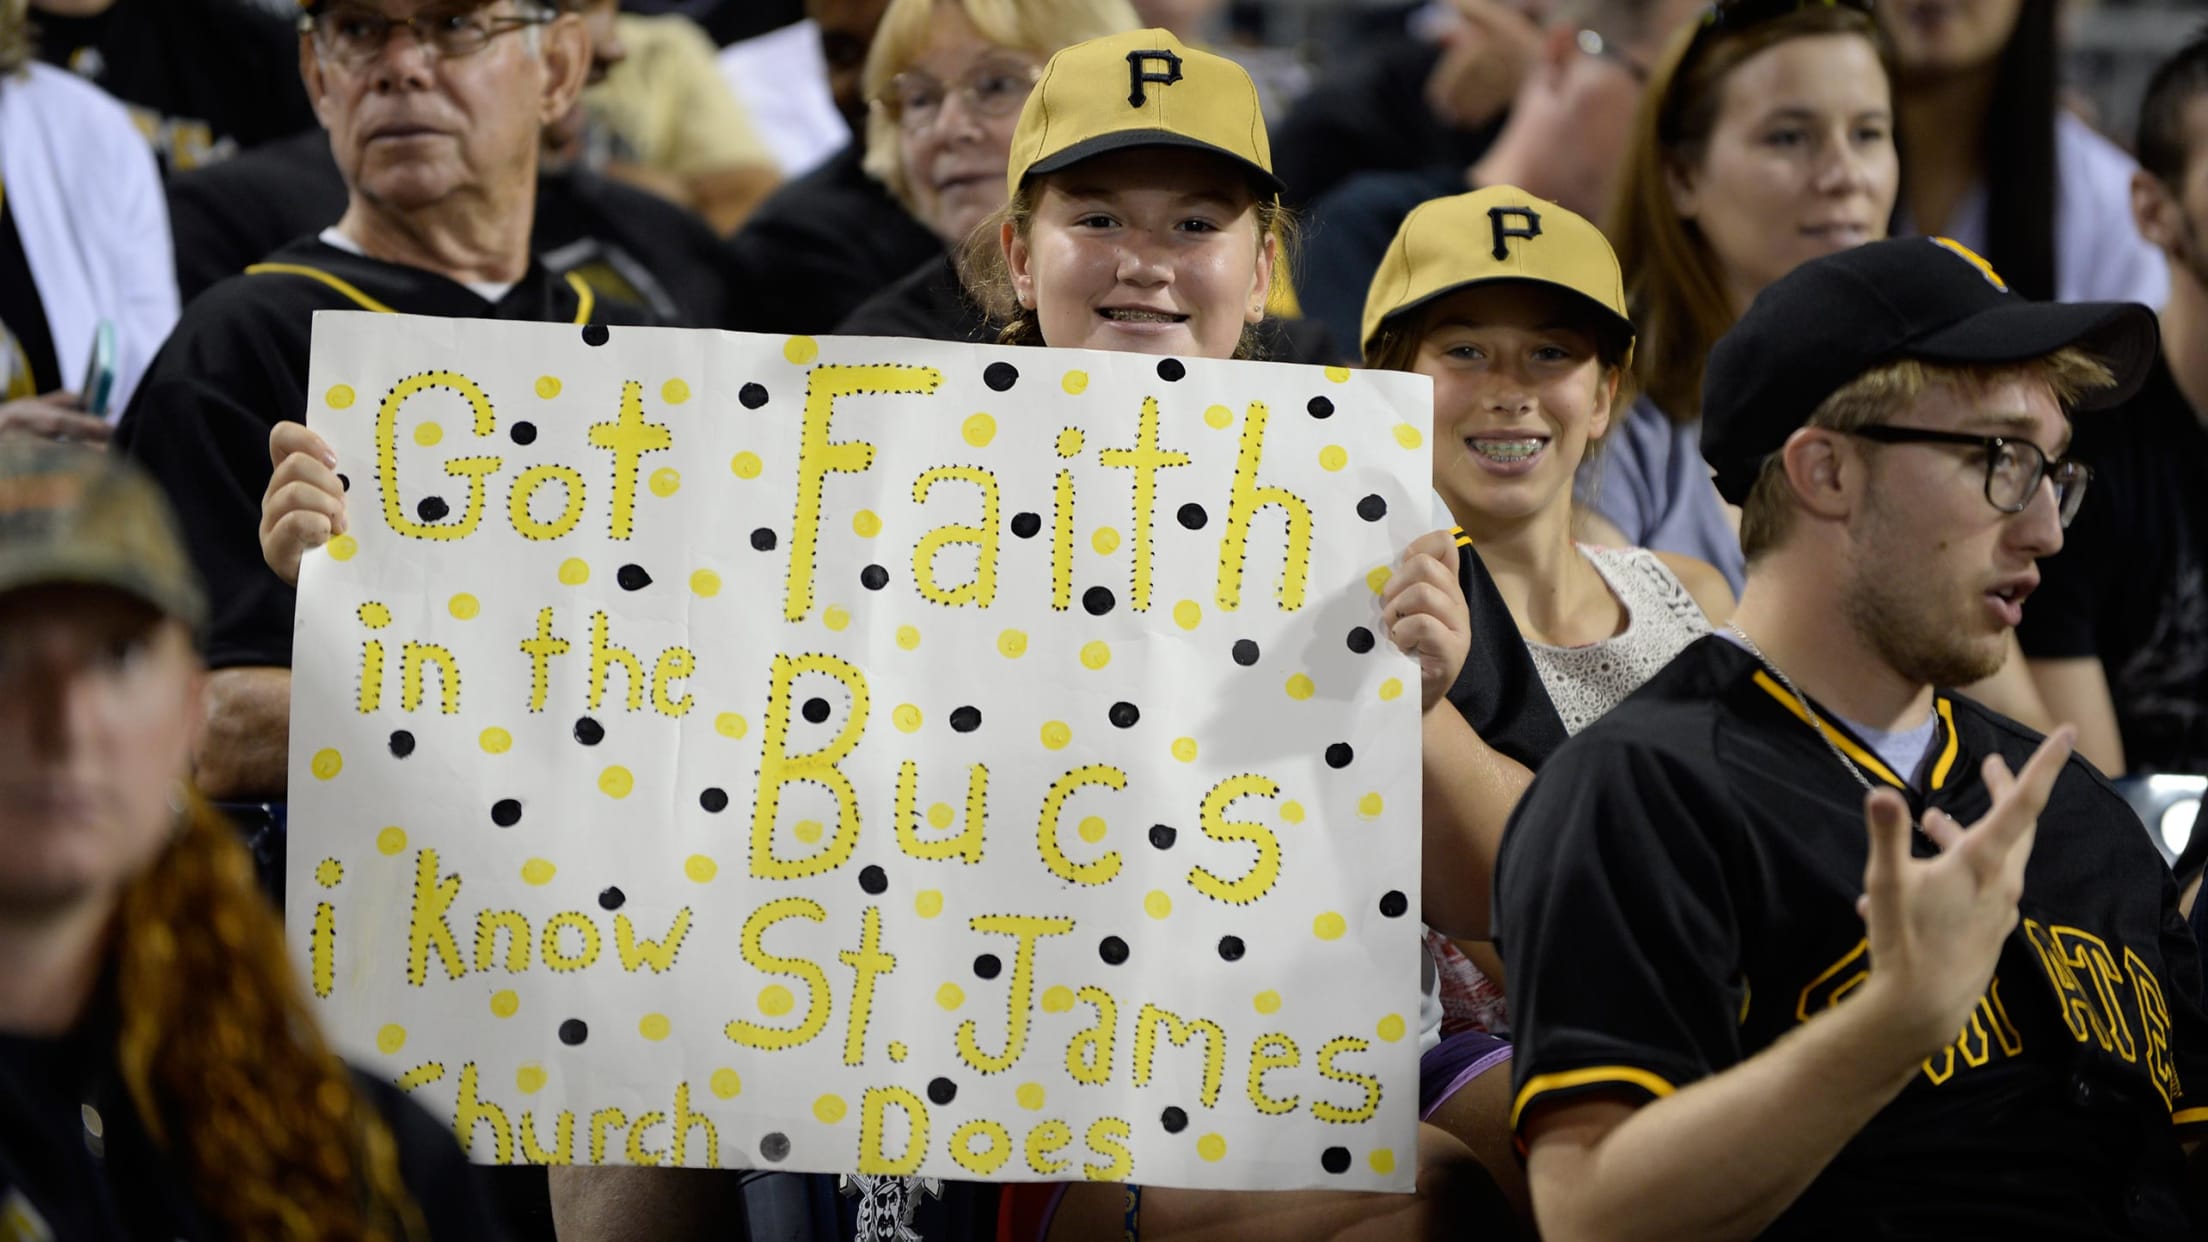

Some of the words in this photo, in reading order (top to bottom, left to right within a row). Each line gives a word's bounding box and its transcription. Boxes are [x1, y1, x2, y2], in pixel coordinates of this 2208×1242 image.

[1125, 48, 1184, 108] P
[1487, 205, 1543, 262] P
[374, 370, 673, 541] Got
[783, 363, 1314, 623] Faith
[357, 600, 462, 715] in
[519, 606, 696, 718] the
[748, 651, 1283, 906] Bucs
[310, 857, 344, 999] i
[407, 847, 693, 988] know
[723, 896, 908, 1067] St.
[954, 914, 1384, 1125] James
[856, 1084, 1135, 1182] Does
